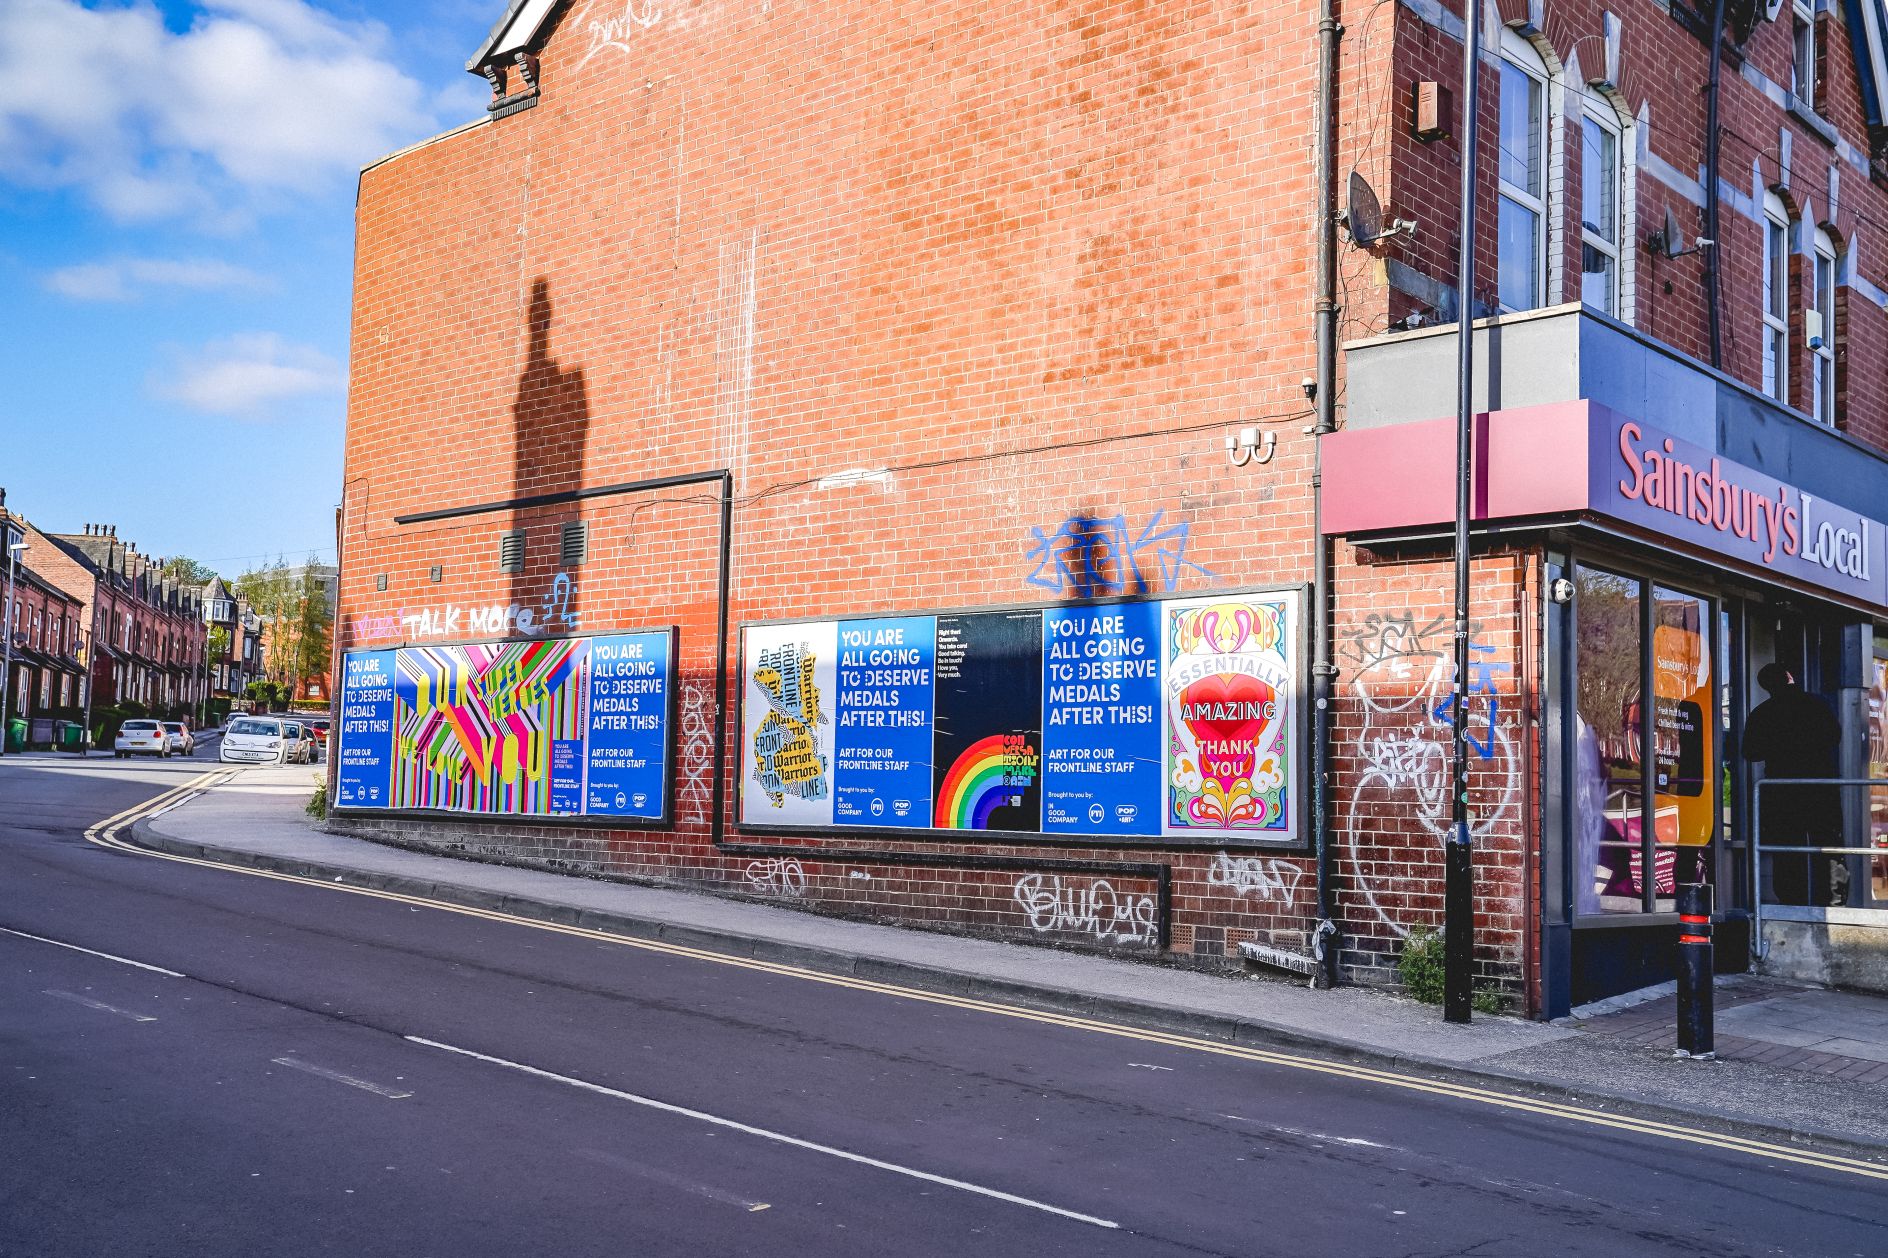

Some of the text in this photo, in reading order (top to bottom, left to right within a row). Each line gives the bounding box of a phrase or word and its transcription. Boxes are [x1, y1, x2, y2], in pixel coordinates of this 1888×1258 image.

[1619, 422, 1870, 581] Sainsbury's Local
[402, 603, 461, 640] TALK
[1049, 616, 1124, 637] YOU ARE
[842, 628, 903, 646] YOU ARE
[595, 644, 643, 660] YOU ARE
[1049, 637, 1145, 659] ALL GOING
[841, 648, 920, 666] ALL GOING
[1657, 655, 1689, 675] Sainsbury's
[348, 659, 379, 673] YOU ARE
[594, 661, 655, 678] ALL GOING
[1049, 660, 1156, 681] TO DESERVE
[1170, 656, 1288, 693] ESSENTIALLY
[347, 674, 387, 688] ALL GOING
[476, 660, 524, 700] SUPER
[782, 642, 798, 708] FRONTLINE
[803, 656, 816, 723] Warriors
[841, 669, 929, 686] TO DESERVE
[594, 679, 662, 695] TO DESERVE
[1049, 684, 1120, 703] MEDALS
[346, 689, 392, 703] TO DESERVE
[489, 677, 550, 723] HEROES
[840, 690, 899, 706] MEDALS
[345, 705, 376, 718] MEDALS
[593, 697, 639, 713] MEDALS
[1181, 700, 1277, 721] AMAZING
[592, 715, 659, 730] AFTER THIS!
[840, 710, 925, 727] AFTER THIS!
[1049, 705, 1152, 725] AFTER THIS!
[345, 720, 389, 733] AFTER THIS!
[755, 733, 781, 753] FRONT
[1197, 740, 1254, 755] THANK
[481, 729, 544, 787] YOU
[591, 749, 633, 757] ART FOR OUR
[773, 751, 812, 768] Warrior
[839, 748, 893, 758] ART FOR OUR
[1048, 749, 1114, 759] ART FOR OUR
[591, 760, 646, 768] FRONTLINE STAFF
[839, 760, 909, 770] FRONTLINE STAFF
[1048, 762, 1134, 773] FRONTLINE STAFF
[1210, 761, 1244, 777] YOU
[801, 778, 819, 798] LINE
